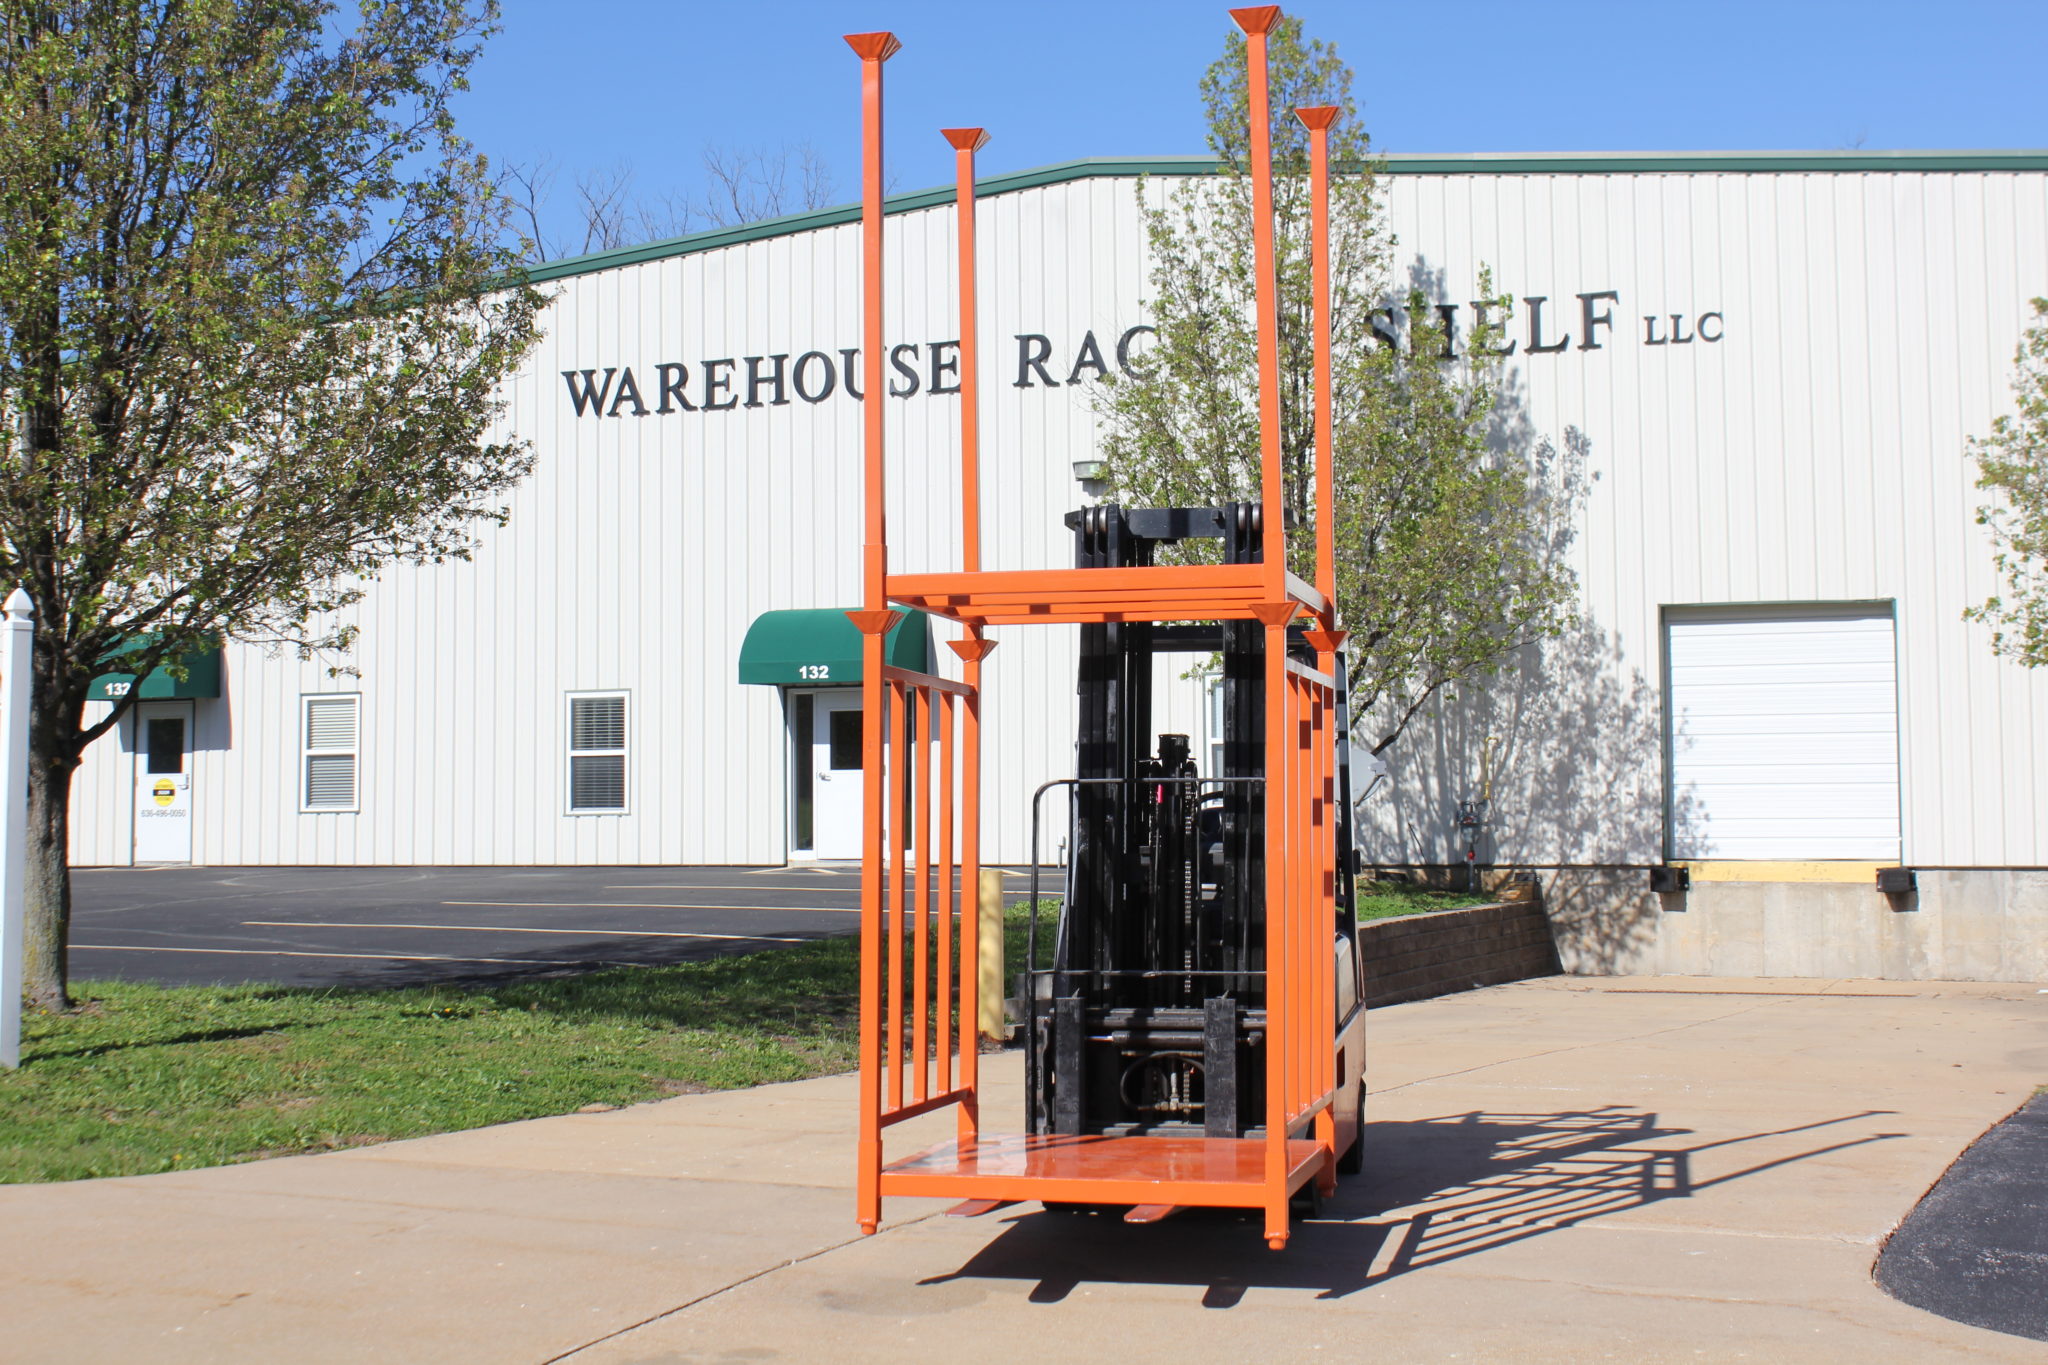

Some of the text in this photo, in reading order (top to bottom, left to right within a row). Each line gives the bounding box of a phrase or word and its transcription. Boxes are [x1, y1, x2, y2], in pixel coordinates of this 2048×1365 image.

[561, 340, 962, 418] WAREHOUSE
[1013, 324, 1210, 388] RAC
[1643, 311, 1724, 347] LLC
[799, 665, 829, 679] 132
